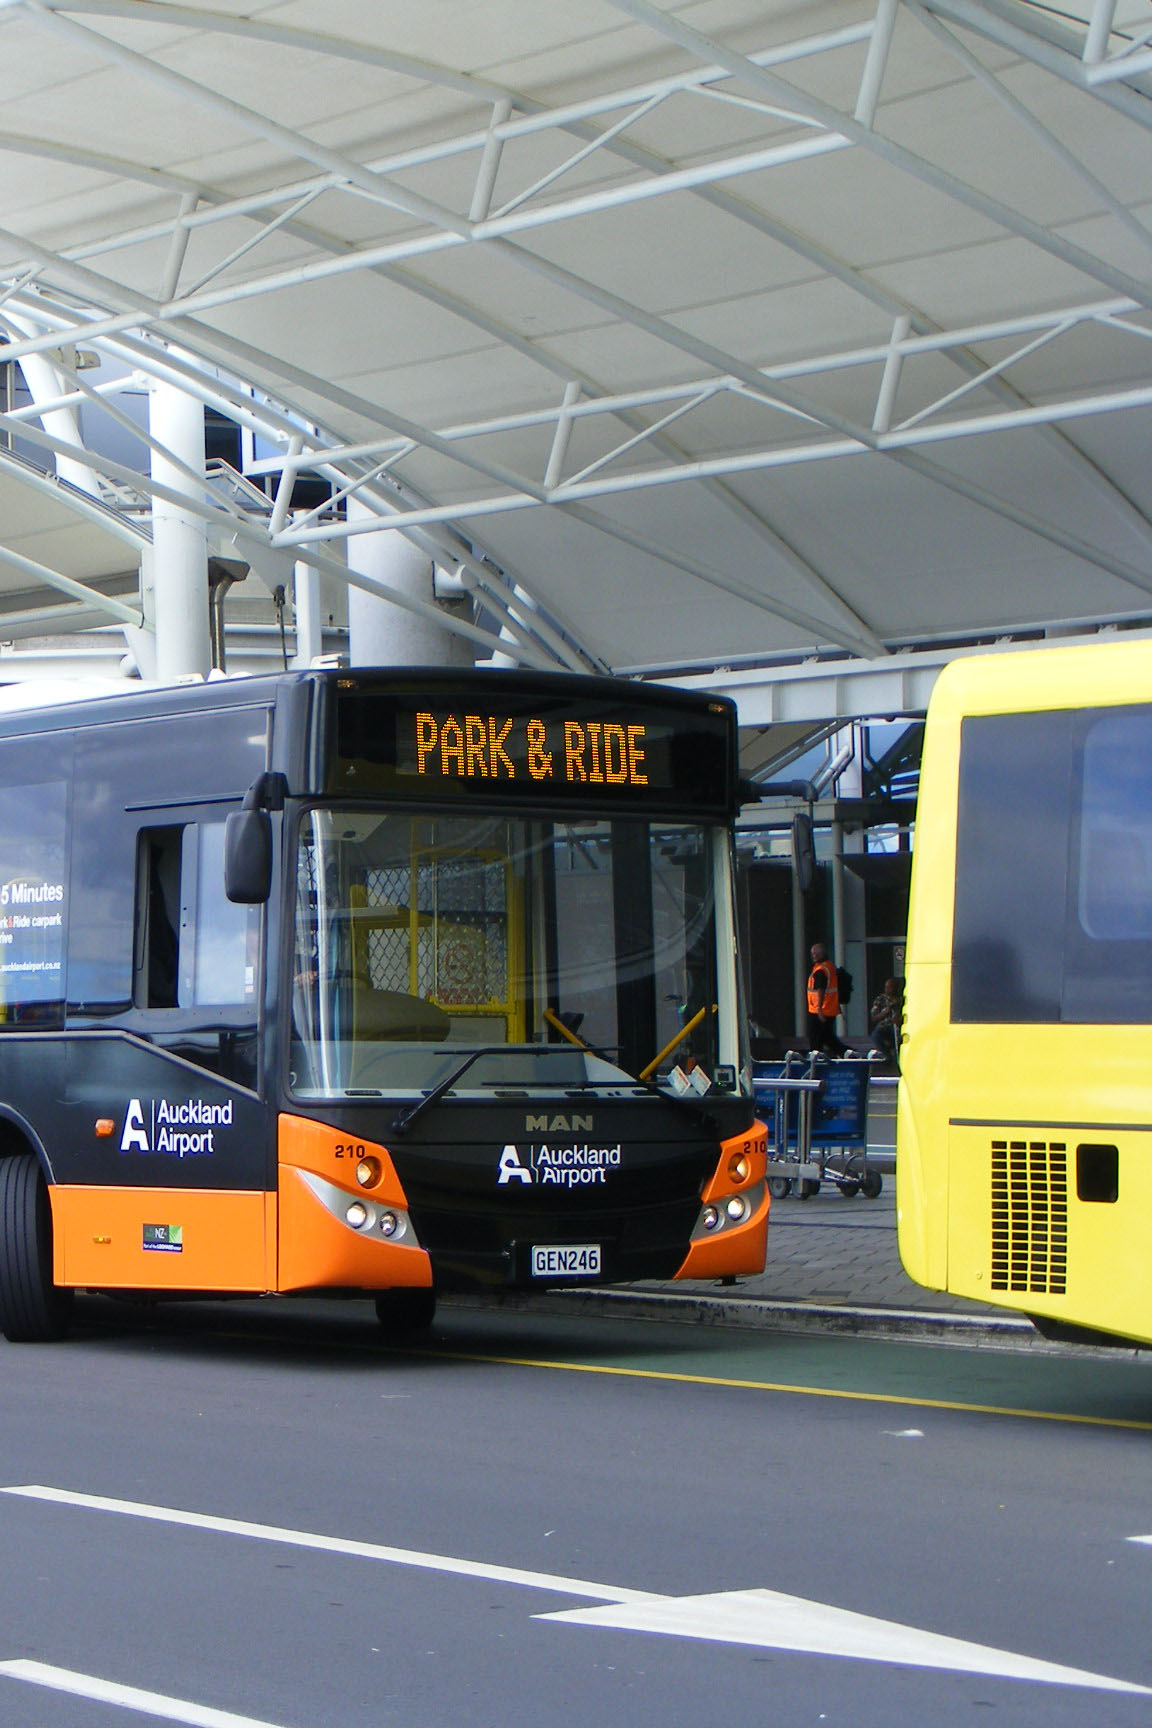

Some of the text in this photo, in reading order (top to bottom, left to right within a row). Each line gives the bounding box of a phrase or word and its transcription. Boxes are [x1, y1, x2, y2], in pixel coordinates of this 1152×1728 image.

[416, 712, 649, 785] PARK & RIDE
[11, 882, 63, 904] Minutes
[31, 912, 62, 929] carpark
[157, 1099, 233, 1125] Auckland
[525, 1115, 593, 1131] MAN
[157, 1127, 214, 1158] Airport
[335, 1144, 365, 1159] 210
[743, 1141, 767, 1154] 210
[537, 1144, 621, 1165] Auckland
[542, 1166, 606, 1188] Airport
[536, 1250, 598, 1271] GEN246
